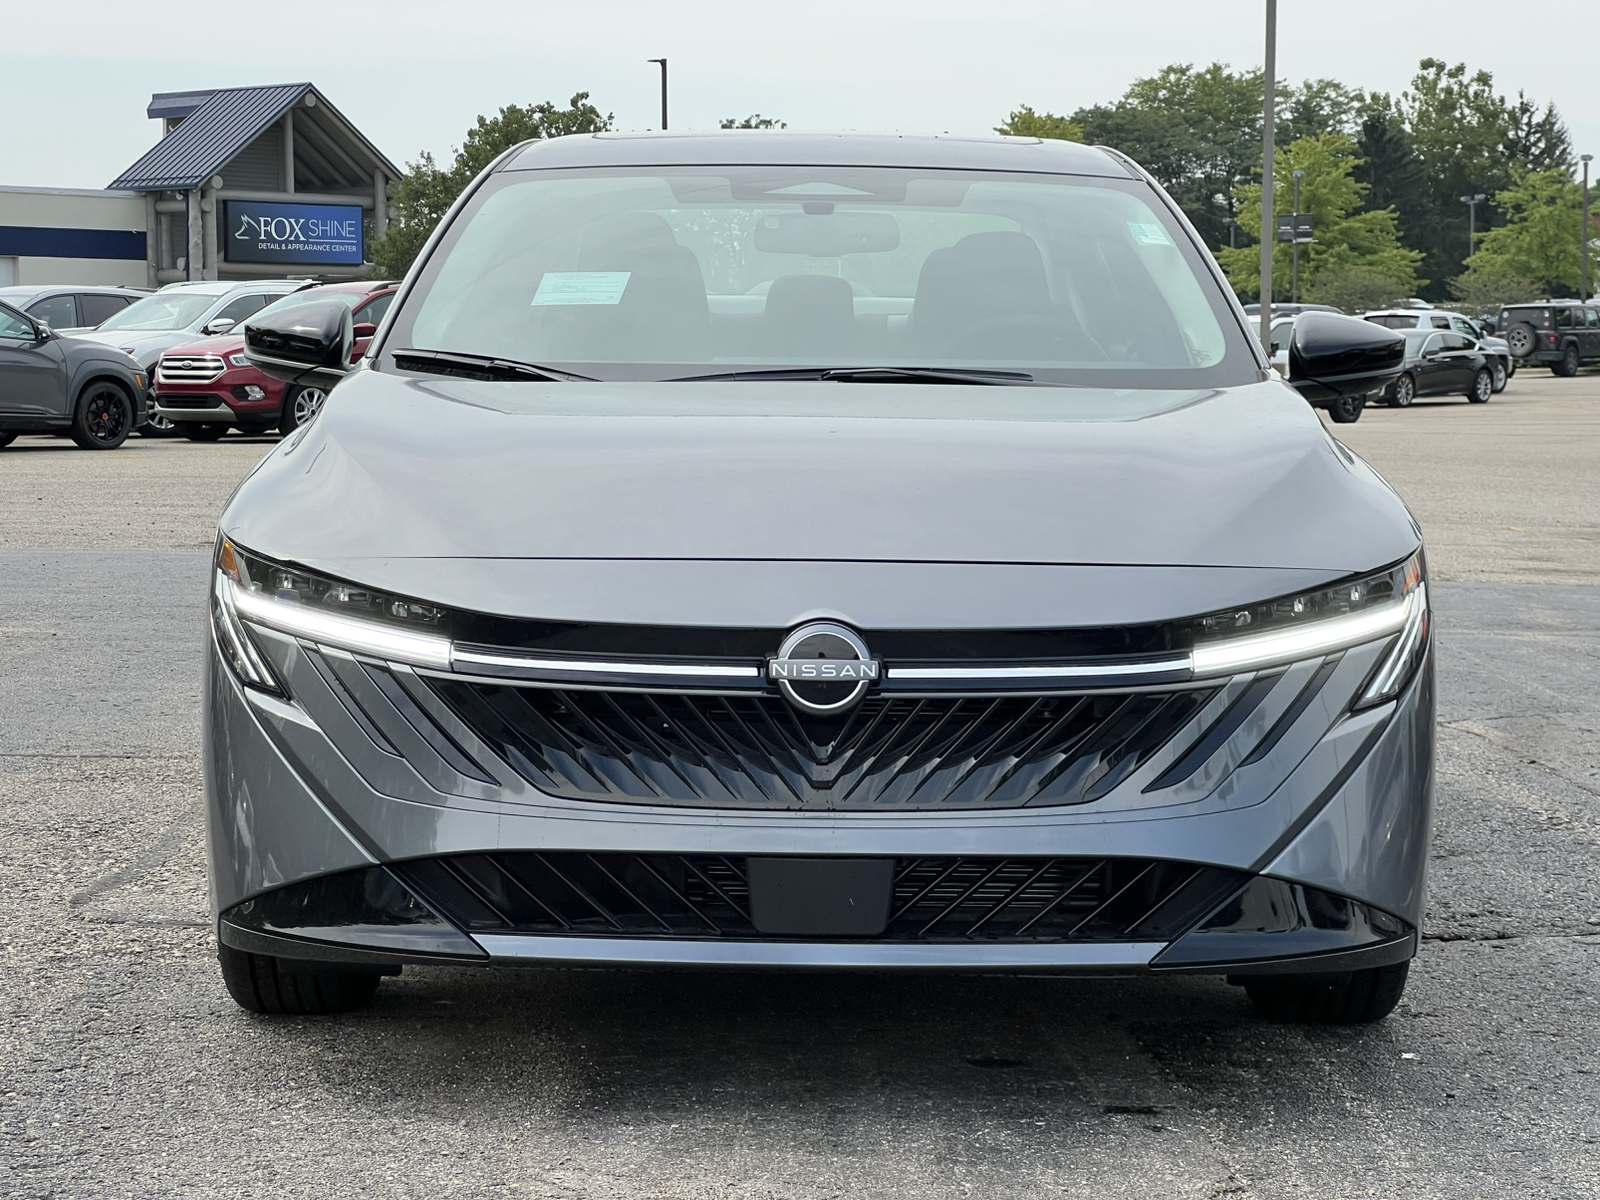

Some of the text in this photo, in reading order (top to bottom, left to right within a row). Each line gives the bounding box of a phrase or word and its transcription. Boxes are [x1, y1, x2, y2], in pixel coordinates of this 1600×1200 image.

[259, 217, 356, 241] FOX SHINE
[258, 242, 280, 250] DETAIL
[287, 243, 331, 252] APPEARANCE
[331, 244, 357, 253] CENTER
[772, 663, 876, 678] NISSAN
